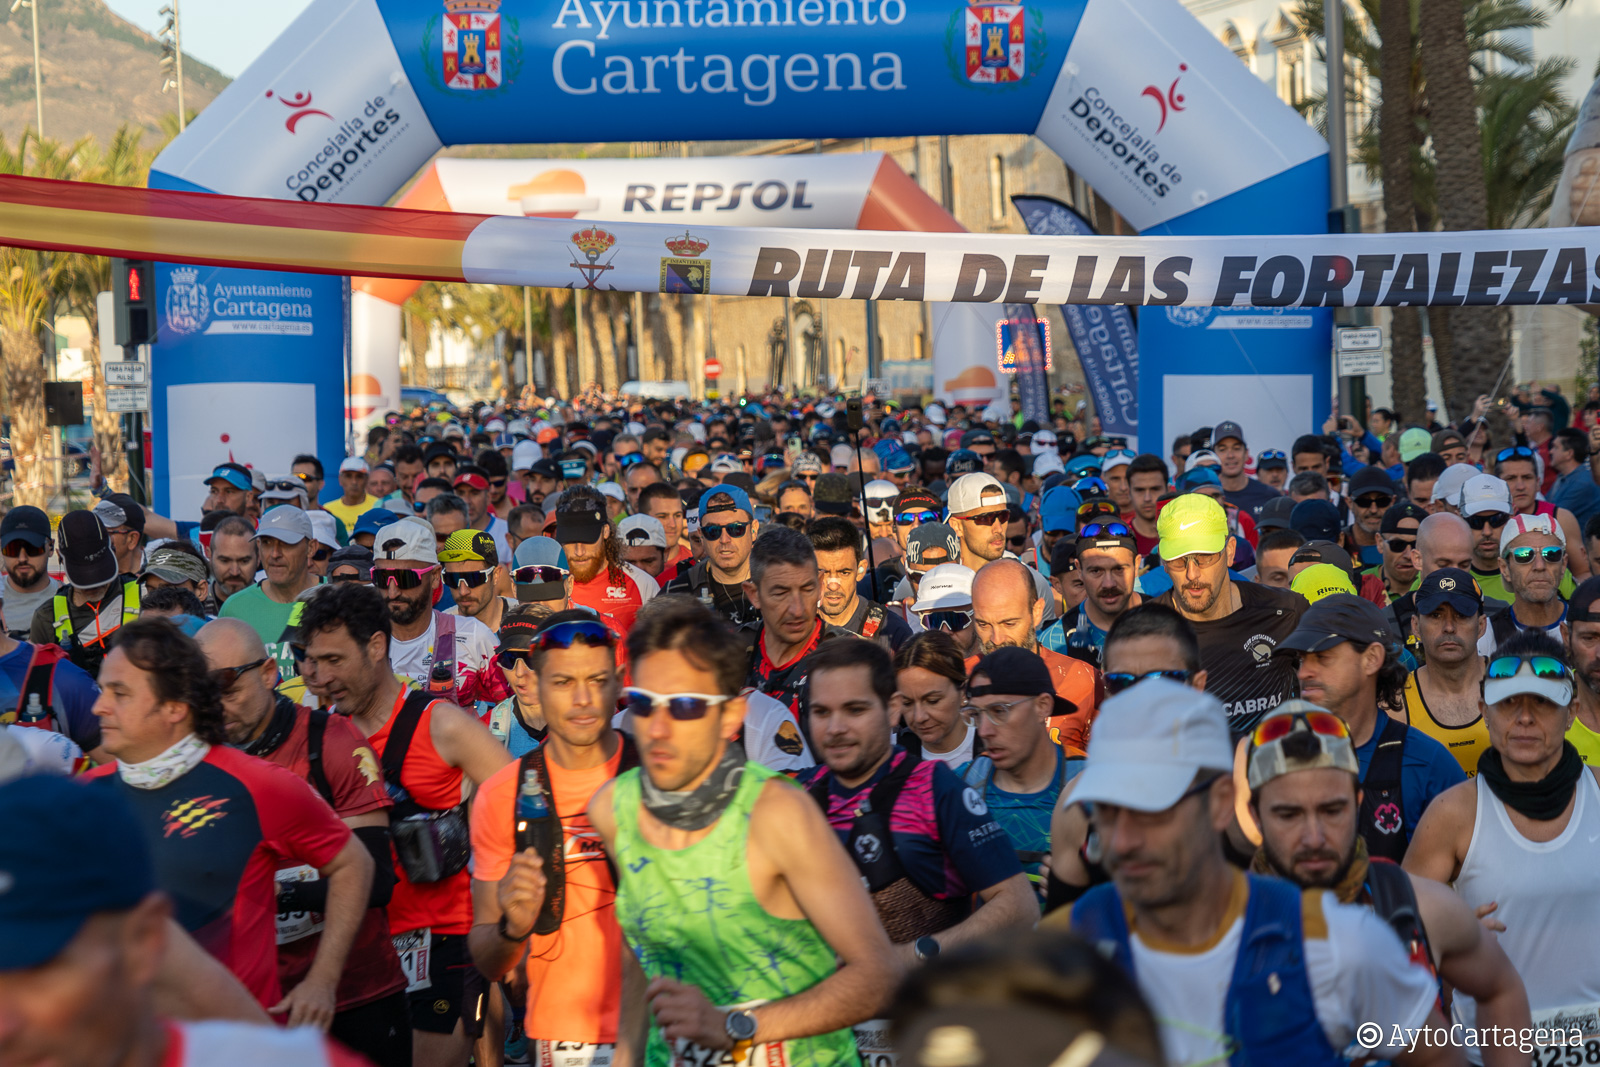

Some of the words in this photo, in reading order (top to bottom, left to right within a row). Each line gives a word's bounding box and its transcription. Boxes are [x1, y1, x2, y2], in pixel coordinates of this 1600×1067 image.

[551, 0, 907, 39] Ayuntamiento
[551, 39, 907, 106] Cartagena
[286, 117, 363, 191] Concejalía
[364, 96, 385, 118] de
[296, 108, 401, 202] Deportes
[1069, 96, 1171, 198] Deportes
[1084, 86, 1160, 164] Concejalía
[1160, 163, 1183, 185] de
[622, 179, 814, 213] REPSOL
[213, 282, 313, 298] Ayuntamiento
[746, 246, 927, 301] RUTA
[950, 253, 1050, 304] DE
[1065, 255, 1194, 306] LAS
[1212, 247, 1600, 306] FORTALEZA
[213, 298, 313, 319] Cartagena
